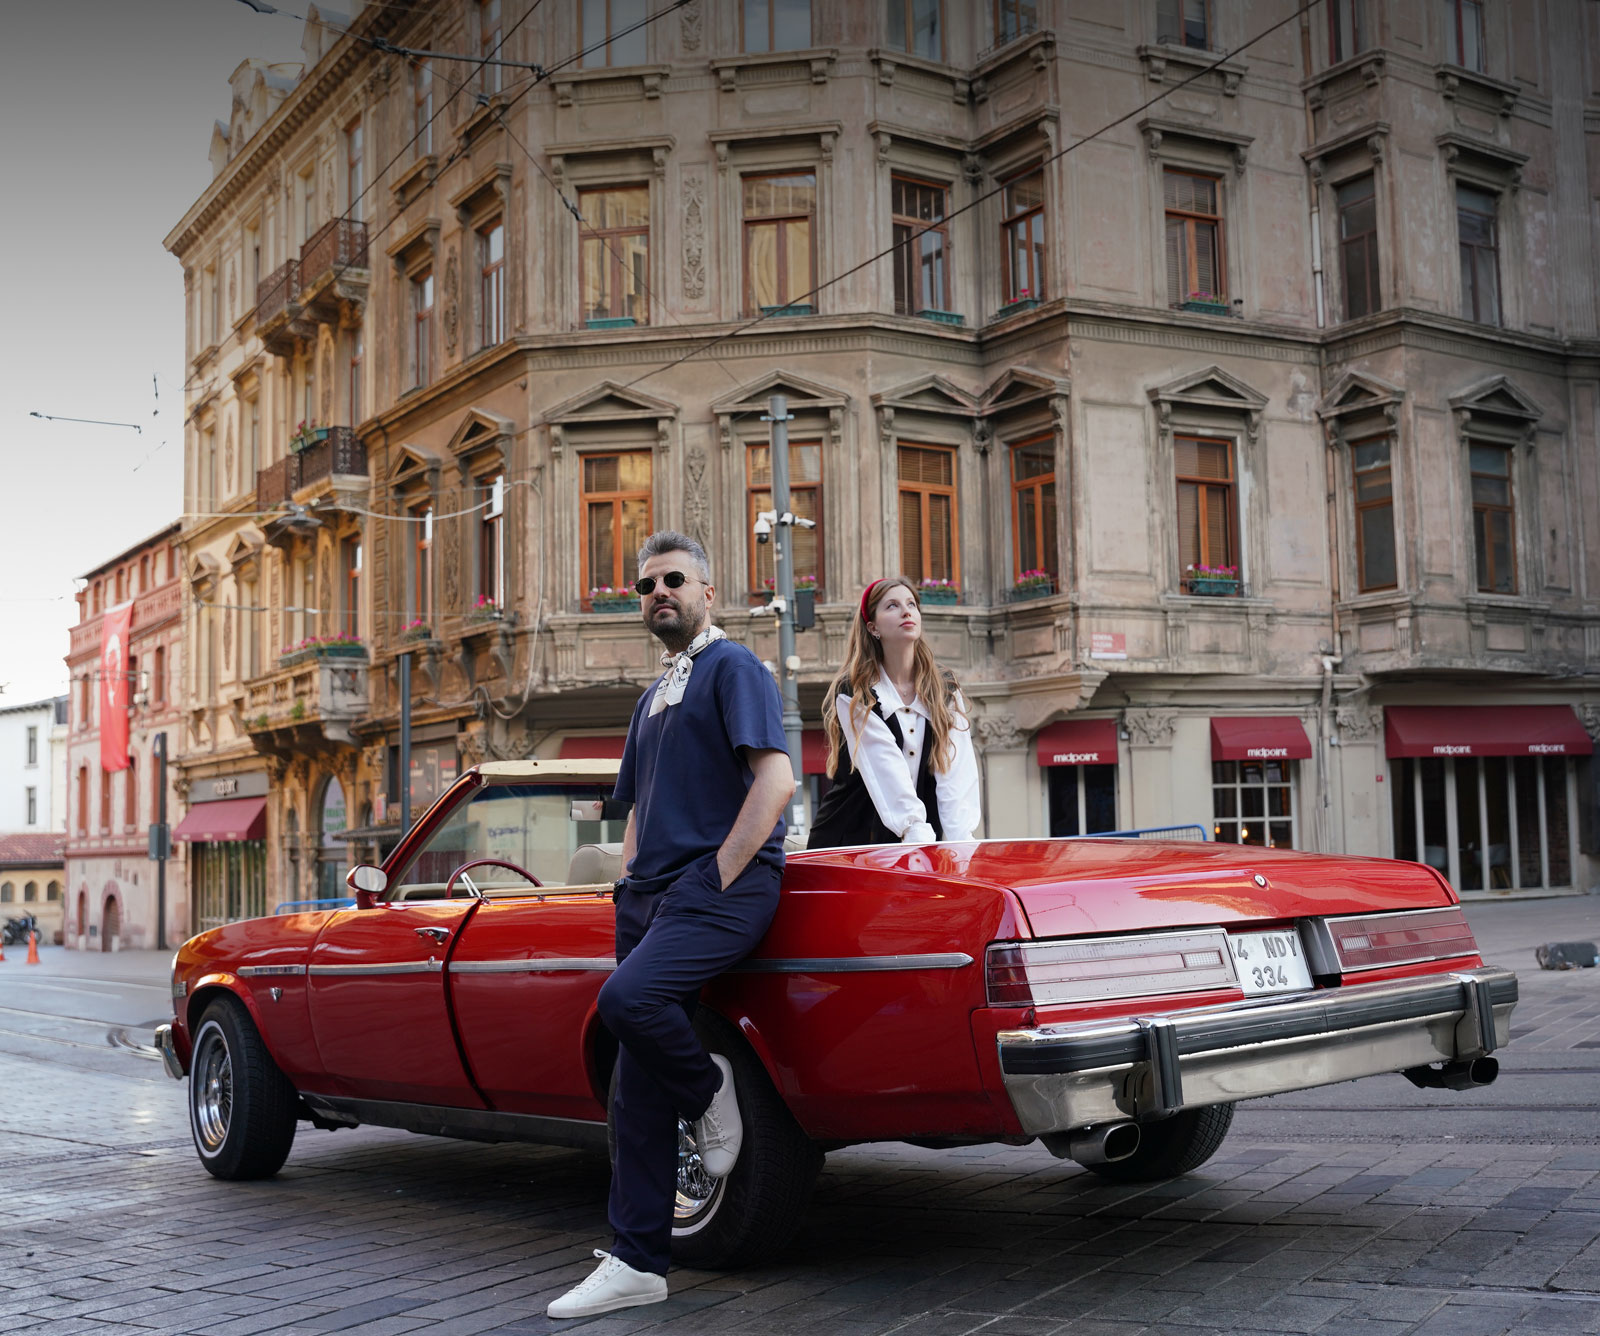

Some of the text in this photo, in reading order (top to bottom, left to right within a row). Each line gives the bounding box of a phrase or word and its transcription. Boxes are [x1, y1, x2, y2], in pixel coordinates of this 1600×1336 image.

[1247, 747, 1287, 758] midpoint
[1433, 745, 1471, 755] midpoint
[1528, 743, 1565, 754] midpoint
[1053, 753, 1099, 763] midpoint
[1230, 936, 1296, 960] 4 NDY
[1252, 965, 1288, 988] 334
